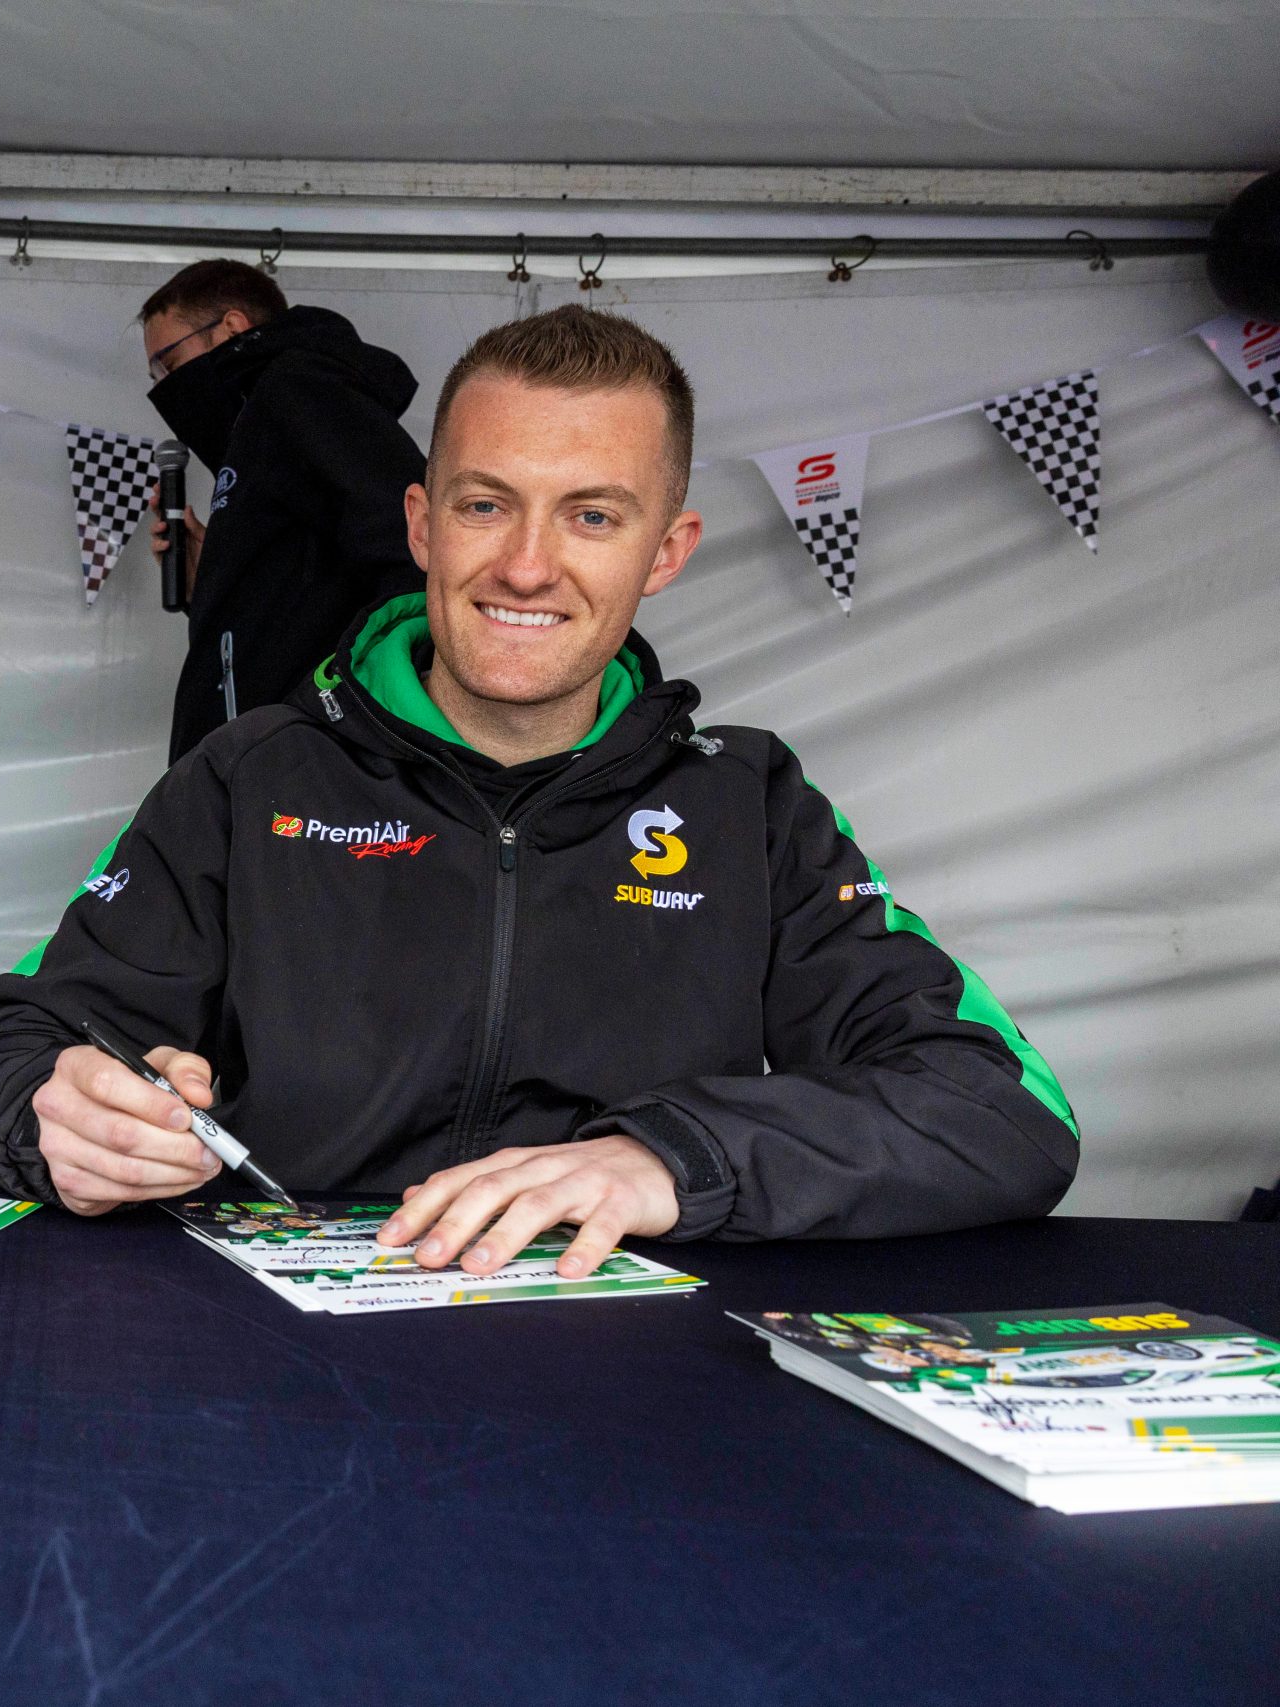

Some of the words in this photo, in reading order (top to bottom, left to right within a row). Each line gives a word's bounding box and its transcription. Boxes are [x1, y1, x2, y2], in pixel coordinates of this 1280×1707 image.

[305, 819, 411, 844] PremiAir
[347, 833, 437, 860] Racing
[613, 884, 705, 911] SUBWAY
[317, 1279, 444, 1292] O'KEEFFE
[356, 1296, 419, 1307] PremiAir
[995, 1312, 1190, 1336] SUBWAY
